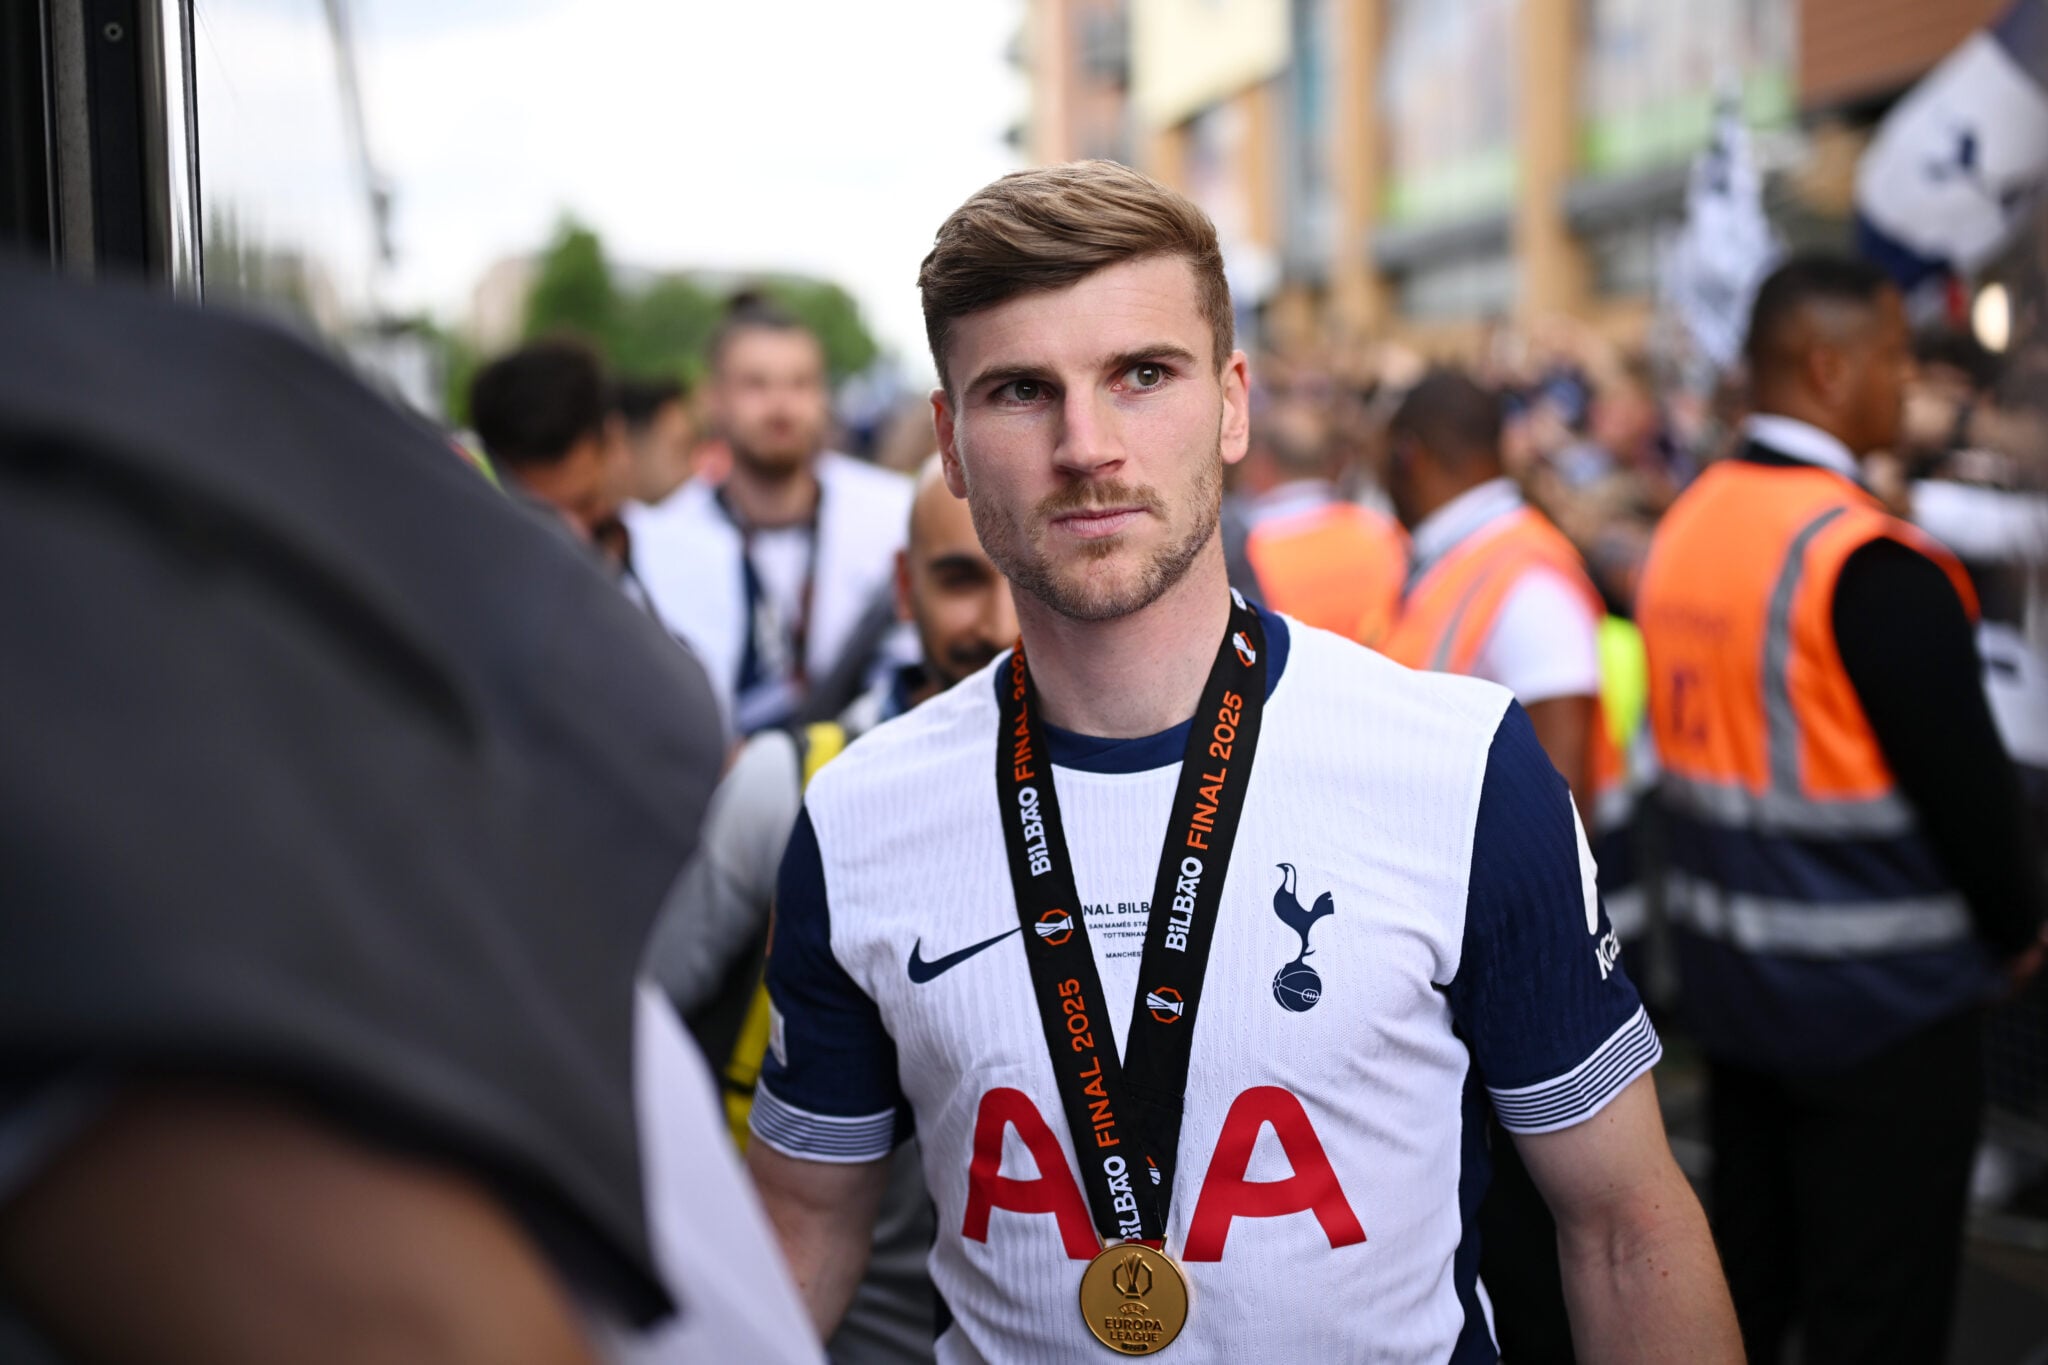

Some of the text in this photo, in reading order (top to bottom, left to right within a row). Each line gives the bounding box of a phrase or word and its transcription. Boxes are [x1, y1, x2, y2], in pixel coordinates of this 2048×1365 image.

[1014, 702, 1035, 782] FINAL
[1186, 768, 1228, 850] FINAL
[1209, 690, 1243, 760] 2025
[1083, 901, 1151, 916] NAL BILB
[1105, 951, 1142, 959] MANCHES
[1595, 928, 1622, 981] Kra
[1058, 978, 1095, 1052] 2025
[1080, 1056, 1120, 1148] FINAL
[961, 1085, 1367, 1262] AA
[1104, 1316, 1163, 1332] EUROPA
[1109, 1330, 1160, 1343] LEAGUE
